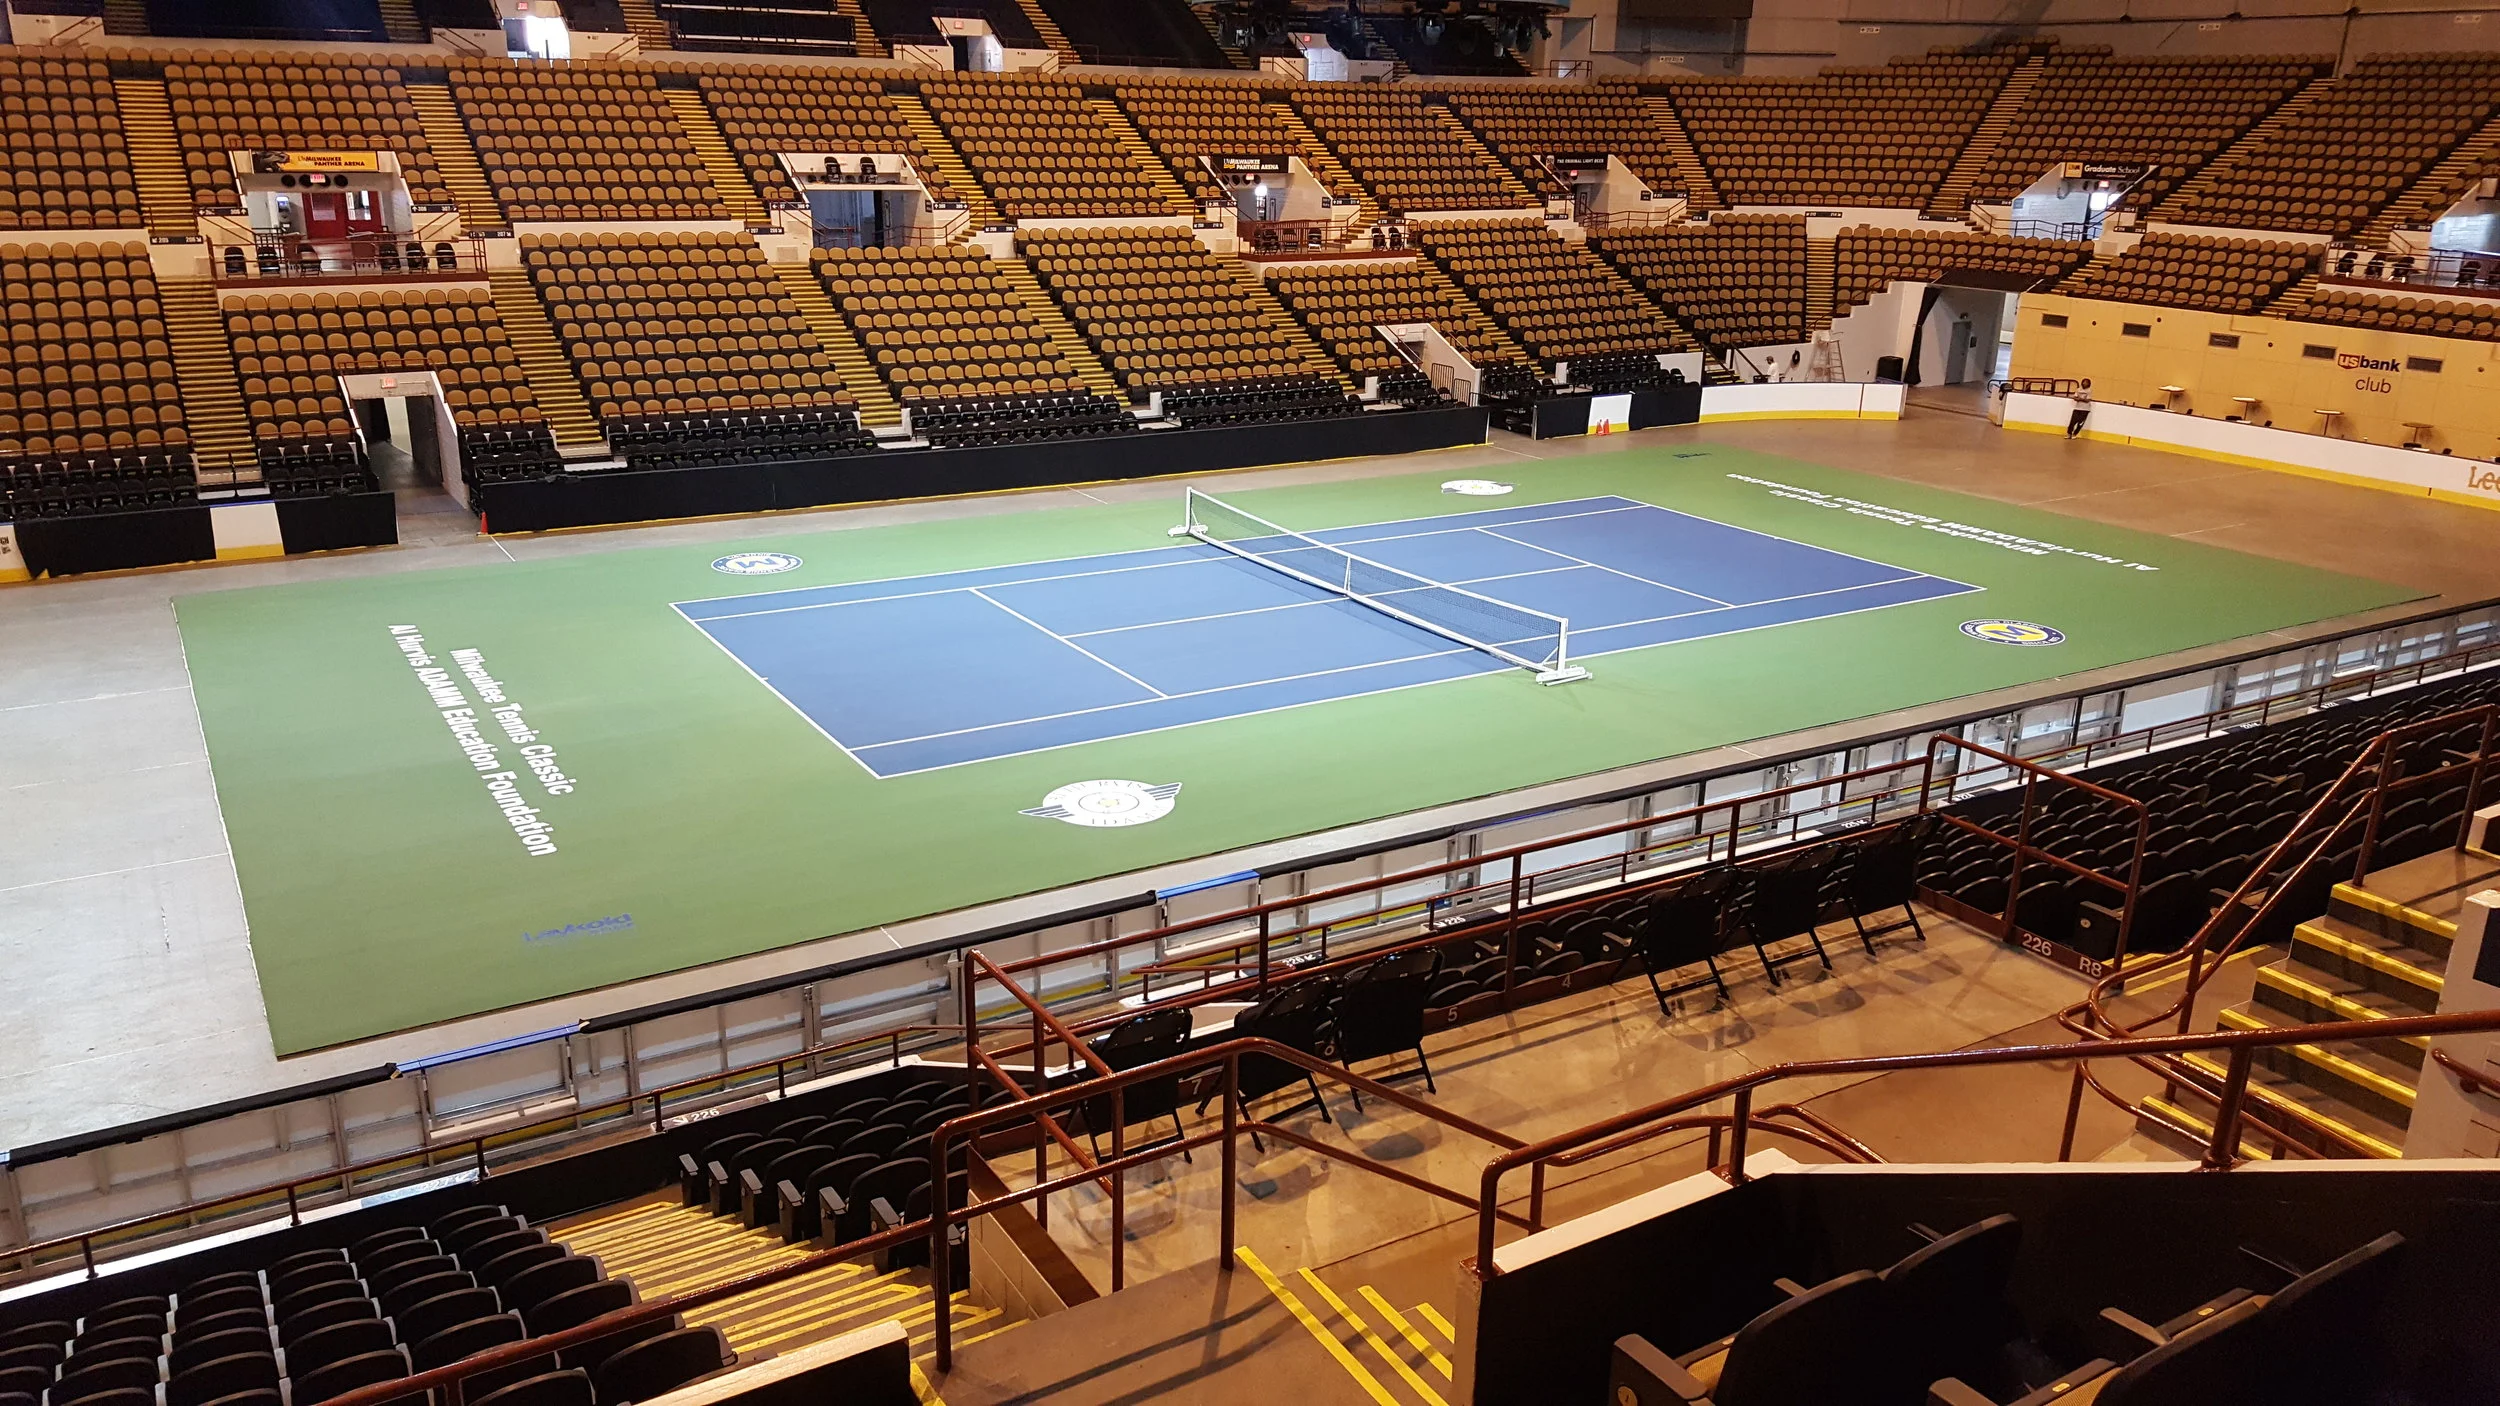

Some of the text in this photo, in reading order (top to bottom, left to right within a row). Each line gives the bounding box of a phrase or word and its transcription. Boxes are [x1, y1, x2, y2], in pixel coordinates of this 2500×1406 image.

[2084, 164, 2117, 174] Graduate
[2117, 165, 2141, 174] School
[2355, 376, 2392, 394] club
[1769, 489, 2050, 555] Milwaukee Tennis Classic
[449, 647, 577, 795] Milwaukee Tennis Classic
[388, 624, 558, 857] Al Hurvis ADAMM Education Foundation
[1445, 915, 1467, 927] 225
[2022, 932, 2102, 977] 226 R8
[1562, 974, 1572, 988] 4
[1447, 1006, 1458, 1022] 5
[1191, 1077, 1203, 1095] 7
[691, 1108, 720, 1122] 226
